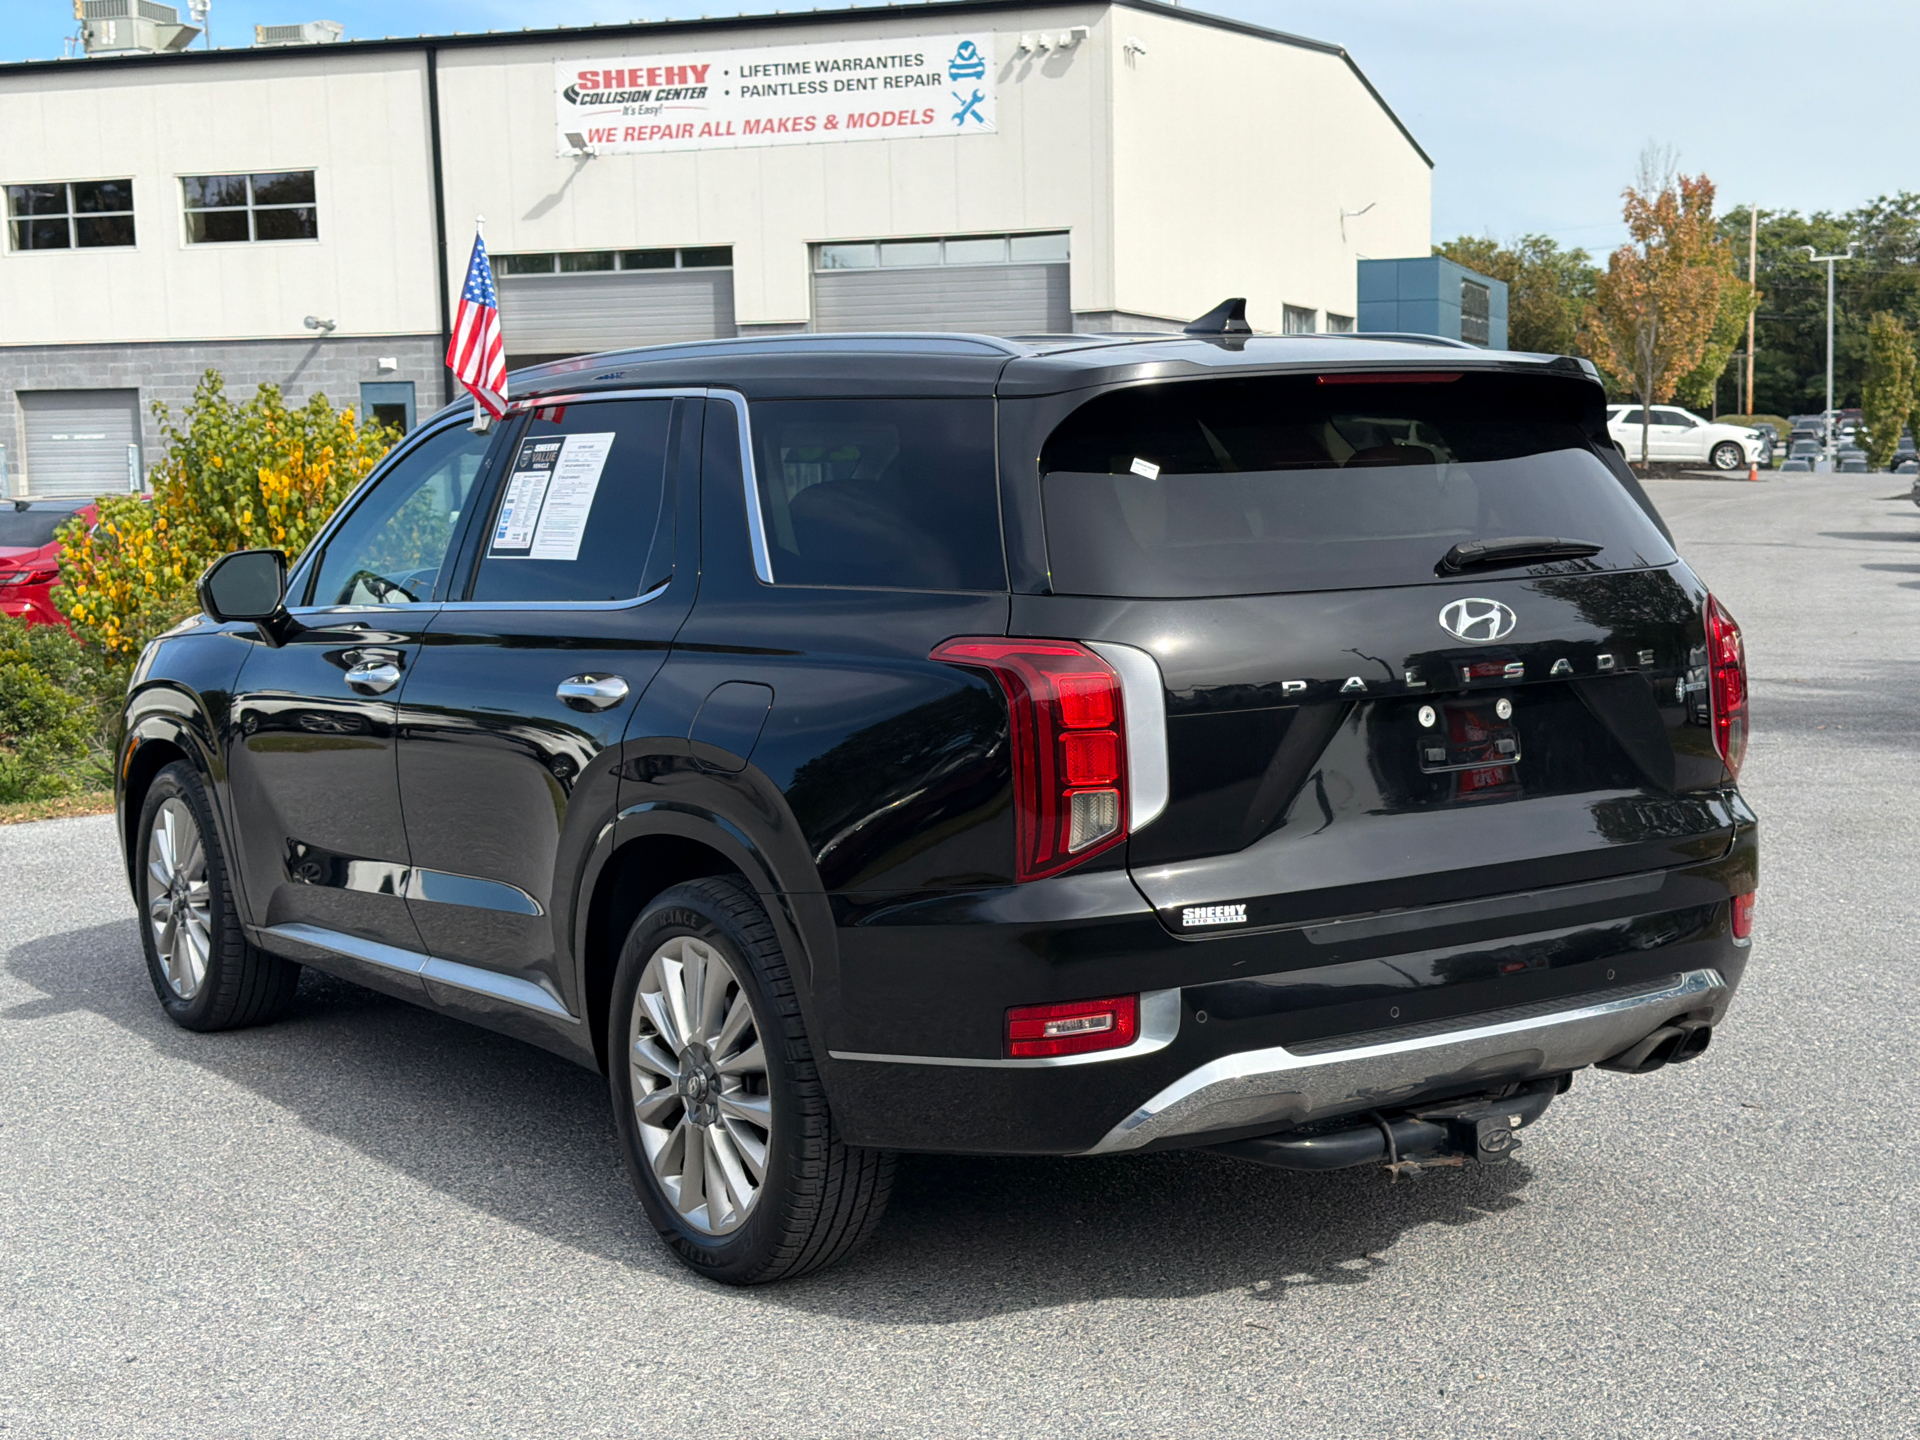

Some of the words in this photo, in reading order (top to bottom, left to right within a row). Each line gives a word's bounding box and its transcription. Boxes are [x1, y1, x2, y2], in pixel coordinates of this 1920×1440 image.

[740, 61, 811, 78] LIFETIME
[815, 53, 924, 73] WARRANTIES
[577, 64, 711, 90] SHEEHY
[740, 80, 828, 98] PAINTLESS
[833, 77, 878, 93] DENT
[883, 73, 942, 89] REPAIR
[580, 90, 652, 105] COLLISION
[655, 87, 708, 102] CENTER
[622, 105, 637, 116] It's
[637, 103, 663, 117] Easy!
[588, 127, 618, 143] WE
[623, 123, 694, 142] REPAIR
[698, 120, 736, 138] ALL
[743, 115, 817, 135] MAKES
[823, 114, 839, 130] &
[846, 108, 935, 129] MODELS
[532, 452, 558, 463] VALUE
[1281, 649, 1655, 698] PALISADE
[1182, 904, 1247, 919] SHEEHY
[1212, 915, 1245, 923] STORES
